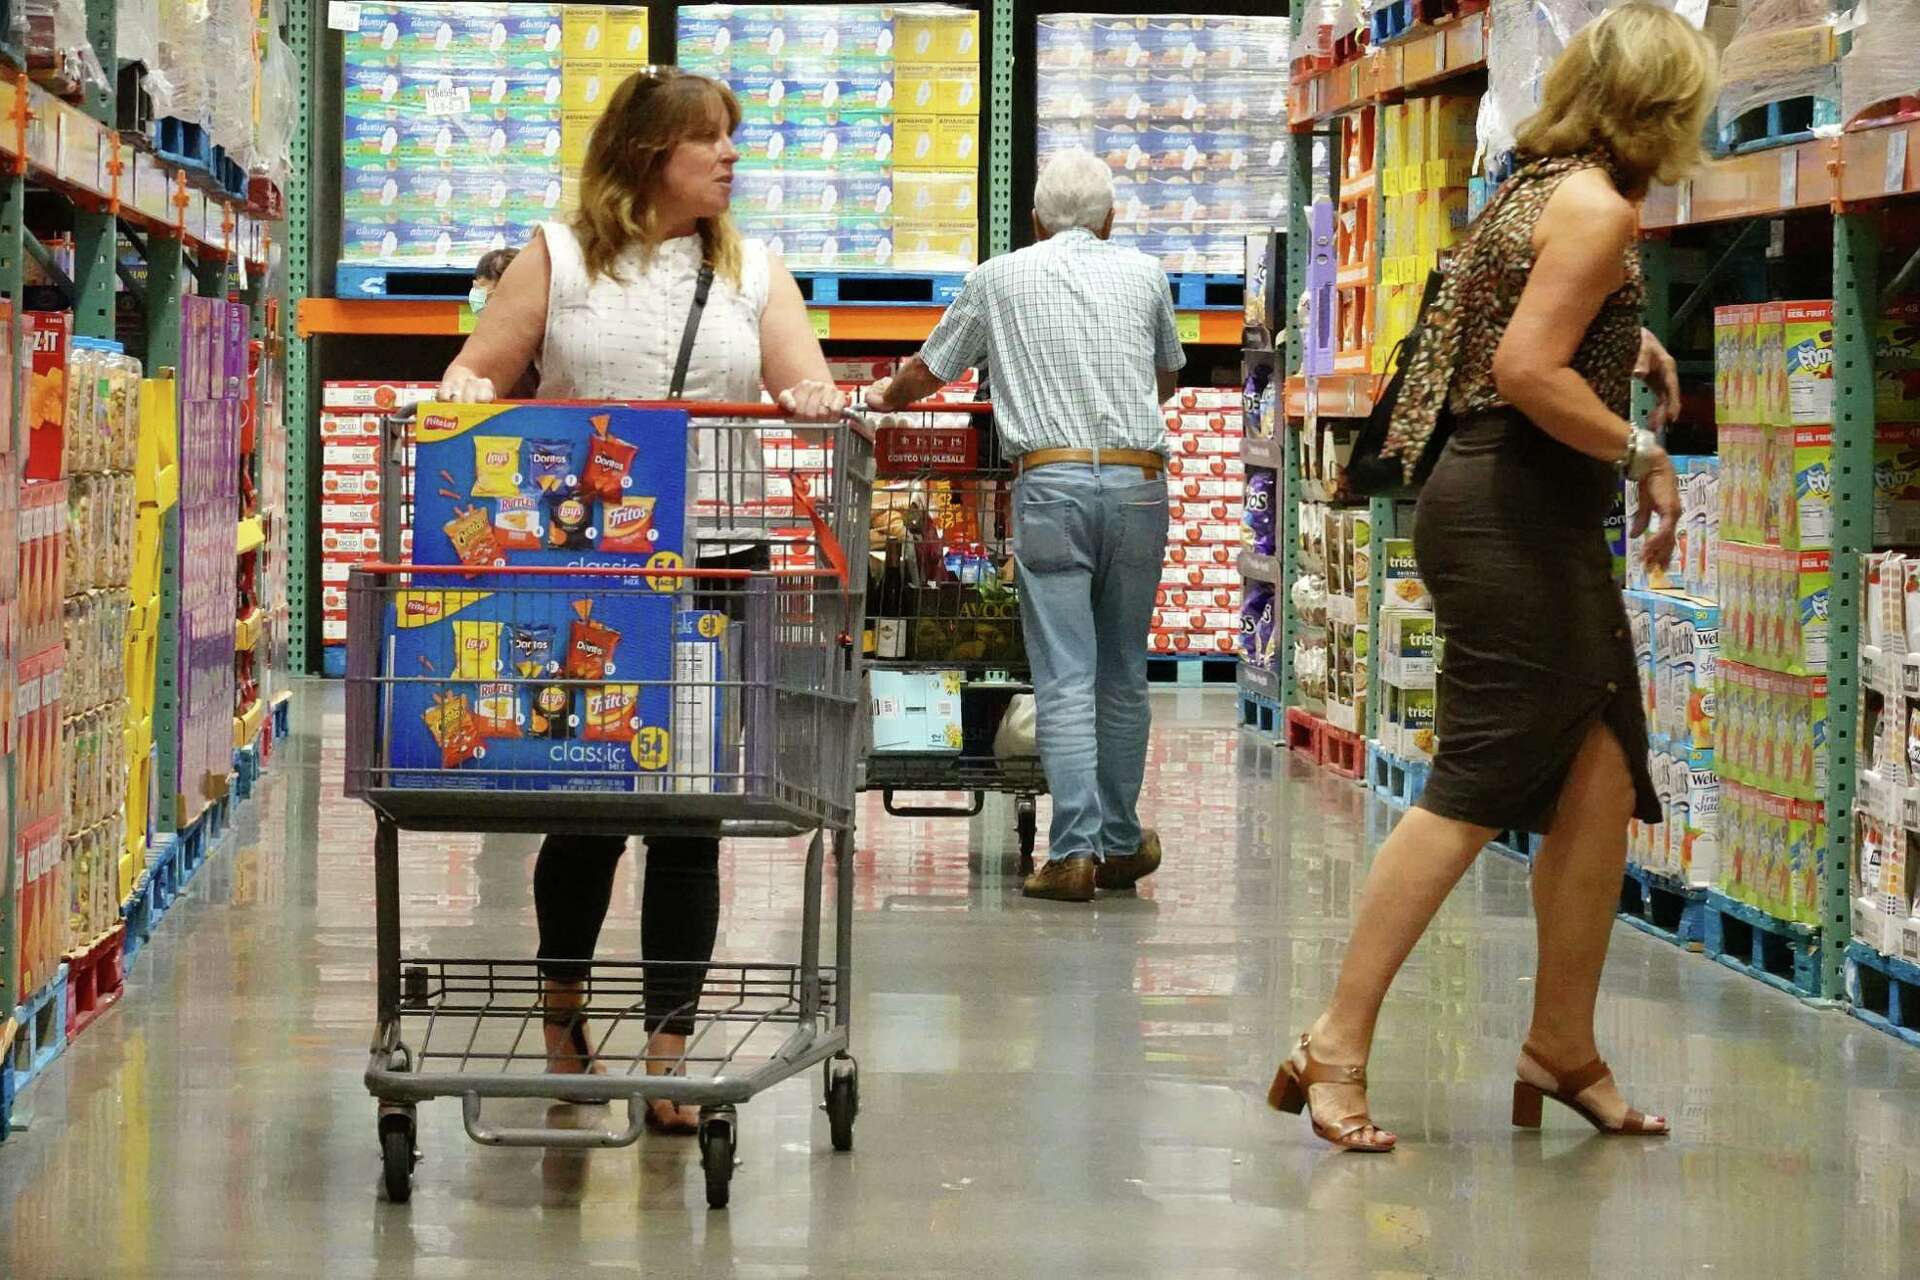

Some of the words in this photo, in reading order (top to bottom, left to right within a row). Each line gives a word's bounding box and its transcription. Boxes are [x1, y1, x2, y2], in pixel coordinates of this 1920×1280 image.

[532, 454, 568, 466] Doritos
[595, 455, 625, 472] Doritos
[888, 454, 918, 463] COSTCO
[609, 506, 646, 527] Fritos
[550, 741, 625, 763] classic
